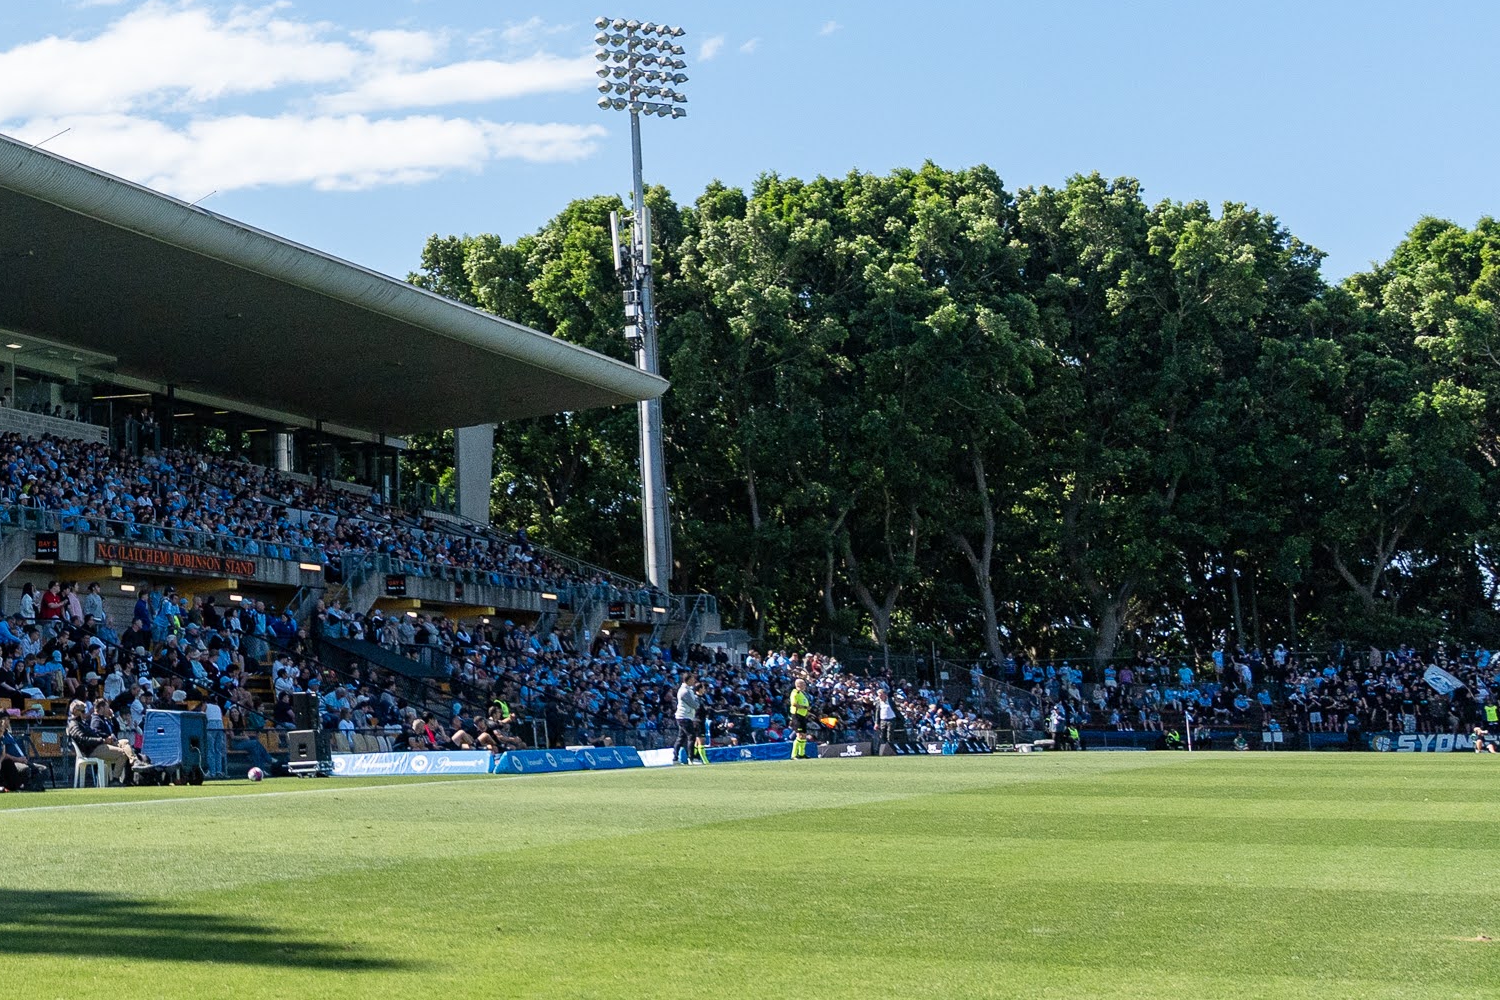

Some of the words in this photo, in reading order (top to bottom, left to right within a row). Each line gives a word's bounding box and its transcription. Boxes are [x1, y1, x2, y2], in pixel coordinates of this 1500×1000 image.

[118, 544, 170, 565] (LATCHEM)
[173, 552, 220, 571] ROBINSON
[225, 558, 254, 575] STAND
[1396, 733, 1500, 752] SYDN
